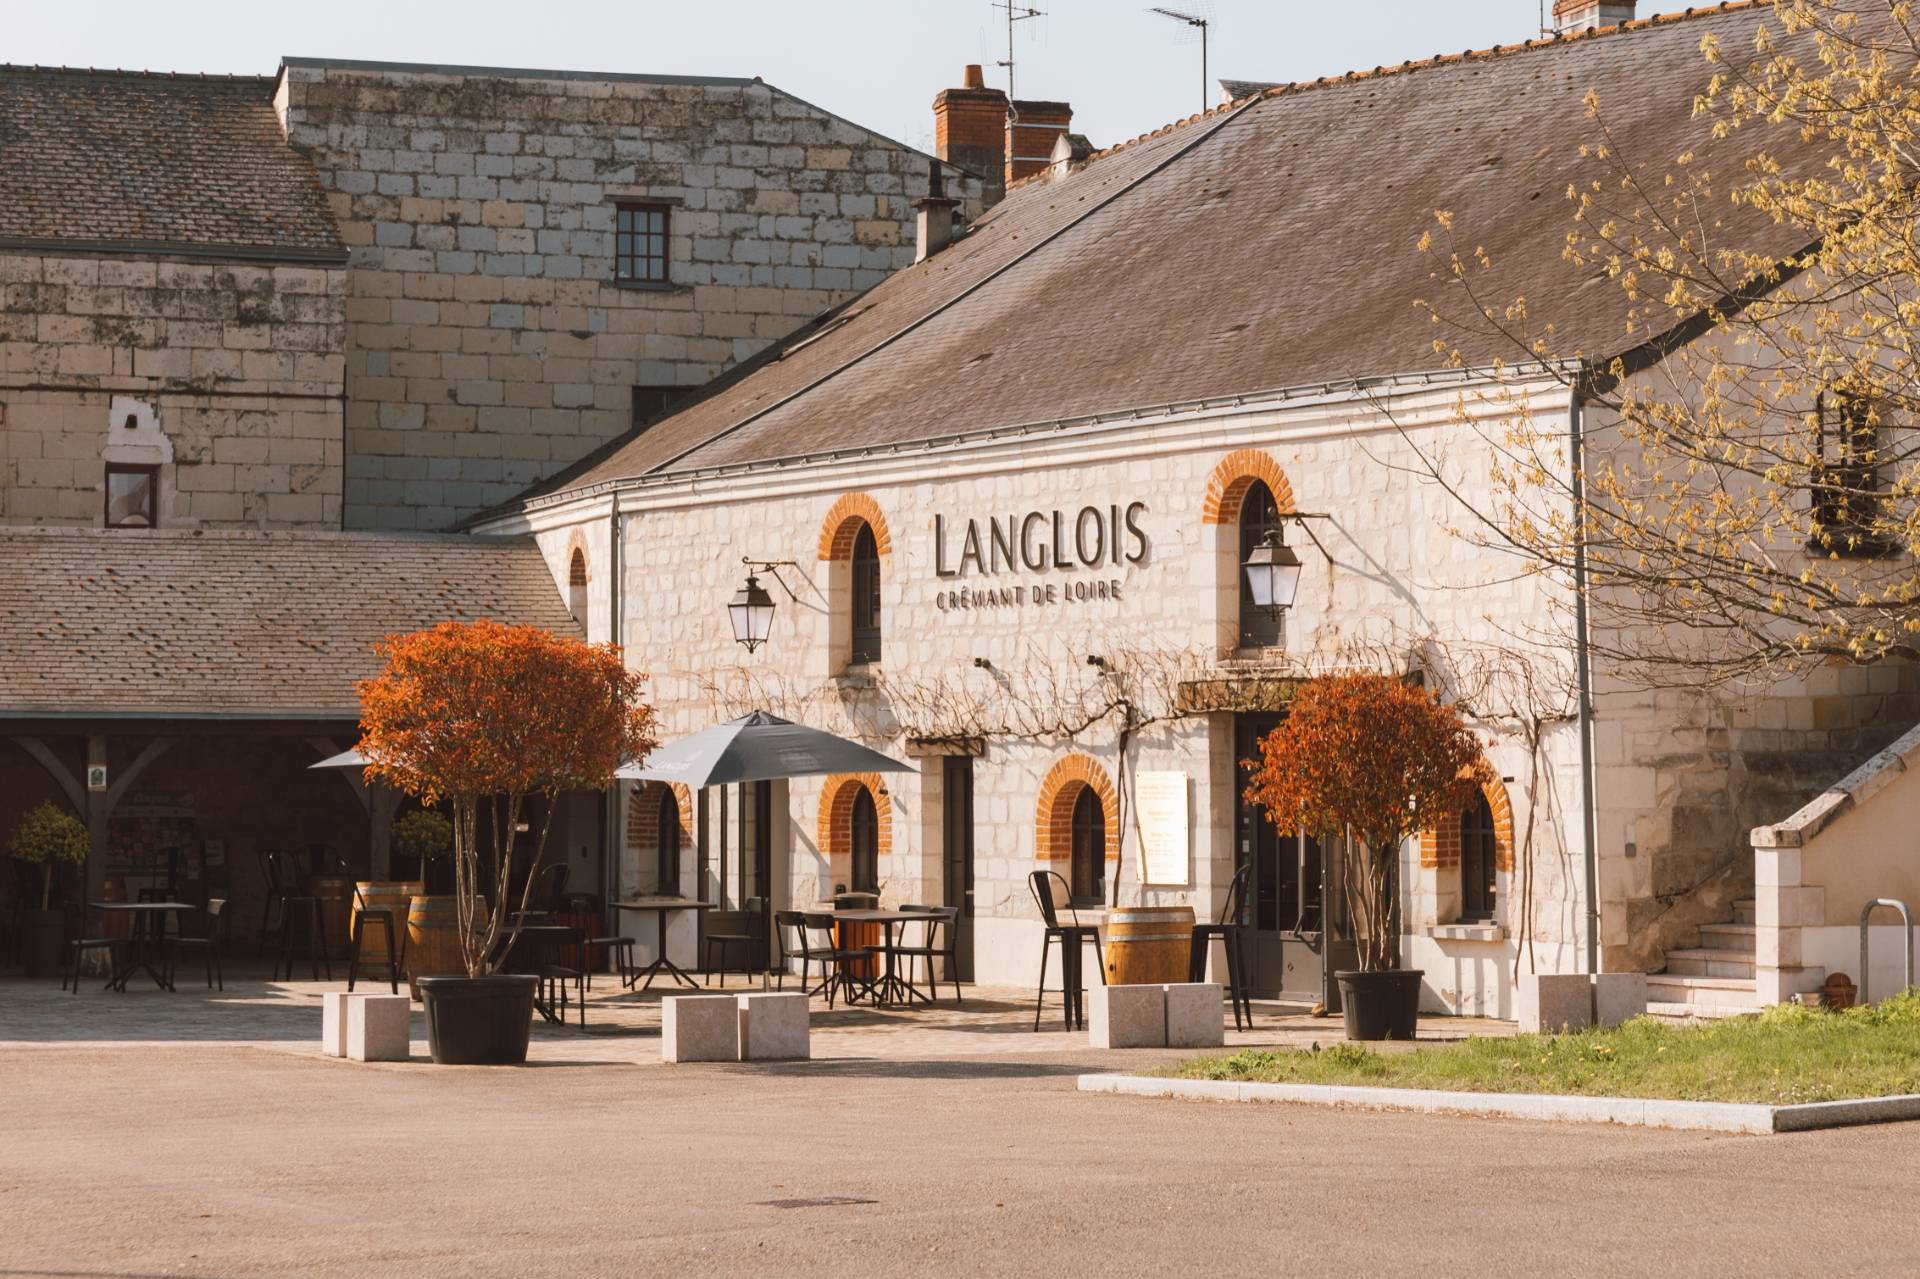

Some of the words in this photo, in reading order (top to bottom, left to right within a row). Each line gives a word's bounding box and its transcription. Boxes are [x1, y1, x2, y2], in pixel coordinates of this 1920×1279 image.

[935, 501, 1147, 577] LANGLOIS
[936, 585, 1024, 610] CRÉMANT
[1032, 584, 1056, 604] DE
[1064, 579, 1121, 601] LOIRE
